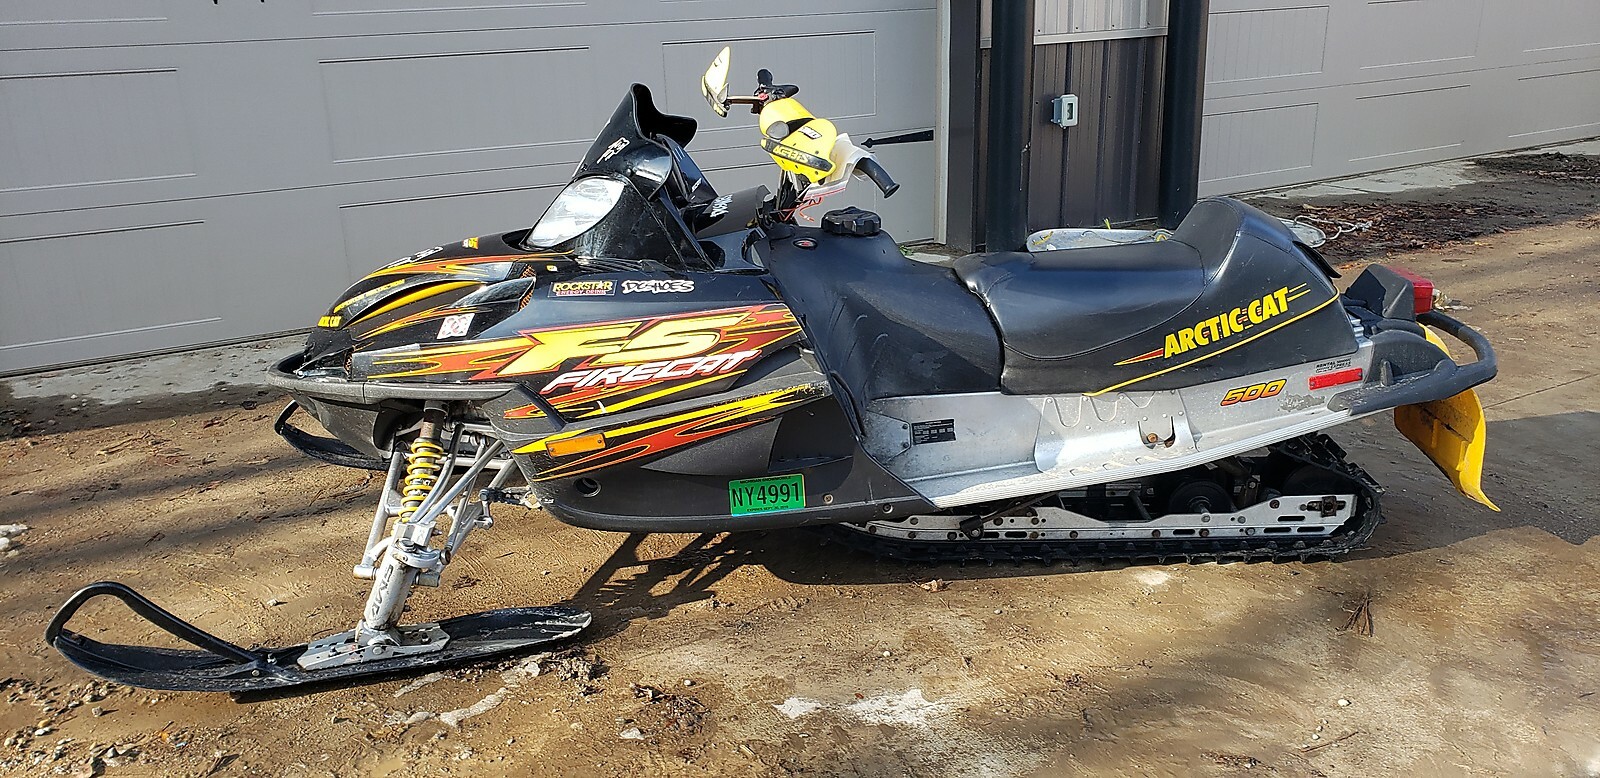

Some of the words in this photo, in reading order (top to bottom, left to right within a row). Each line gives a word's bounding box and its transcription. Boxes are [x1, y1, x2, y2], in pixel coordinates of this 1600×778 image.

[553, 280, 613, 293] ROCKSTAR
[1163, 307, 1244, 358] ARCTIC
[1247, 286, 1289, 325] CAT
[541, 349, 763, 394] FIRECAT
[1220, 378, 1288, 407] 500
[732, 482, 799, 507] NY4991
